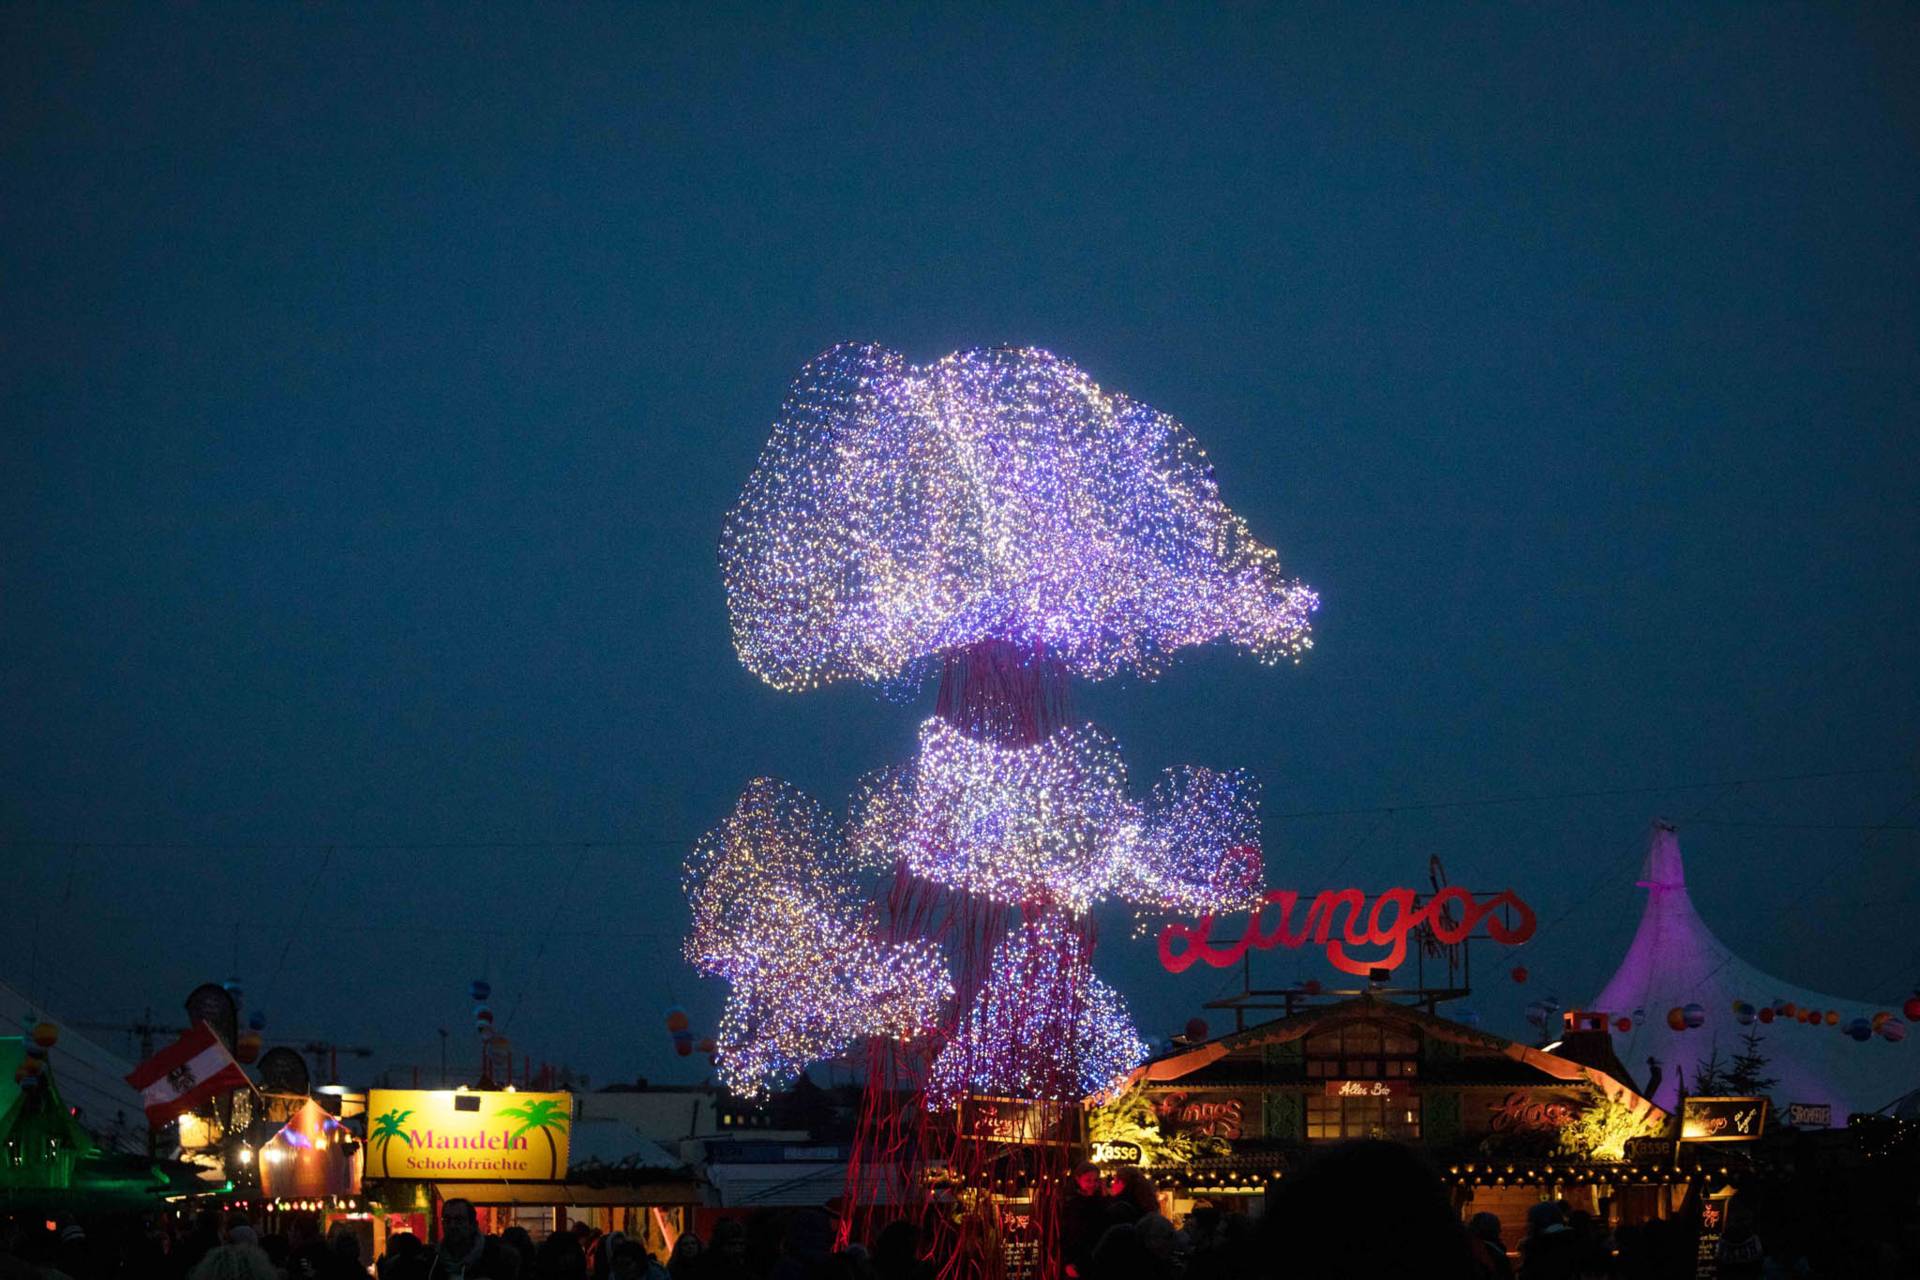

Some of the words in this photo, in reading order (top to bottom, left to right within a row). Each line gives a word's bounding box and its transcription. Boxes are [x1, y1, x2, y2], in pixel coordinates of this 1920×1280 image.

[408, 1129, 528, 1151] Mandeln
[1627, 1139, 1670, 1159] Kasse
[1092, 1142, 1138, 1163] Kasse
[406, 1157, 528, 1171] Schokofrüchte
